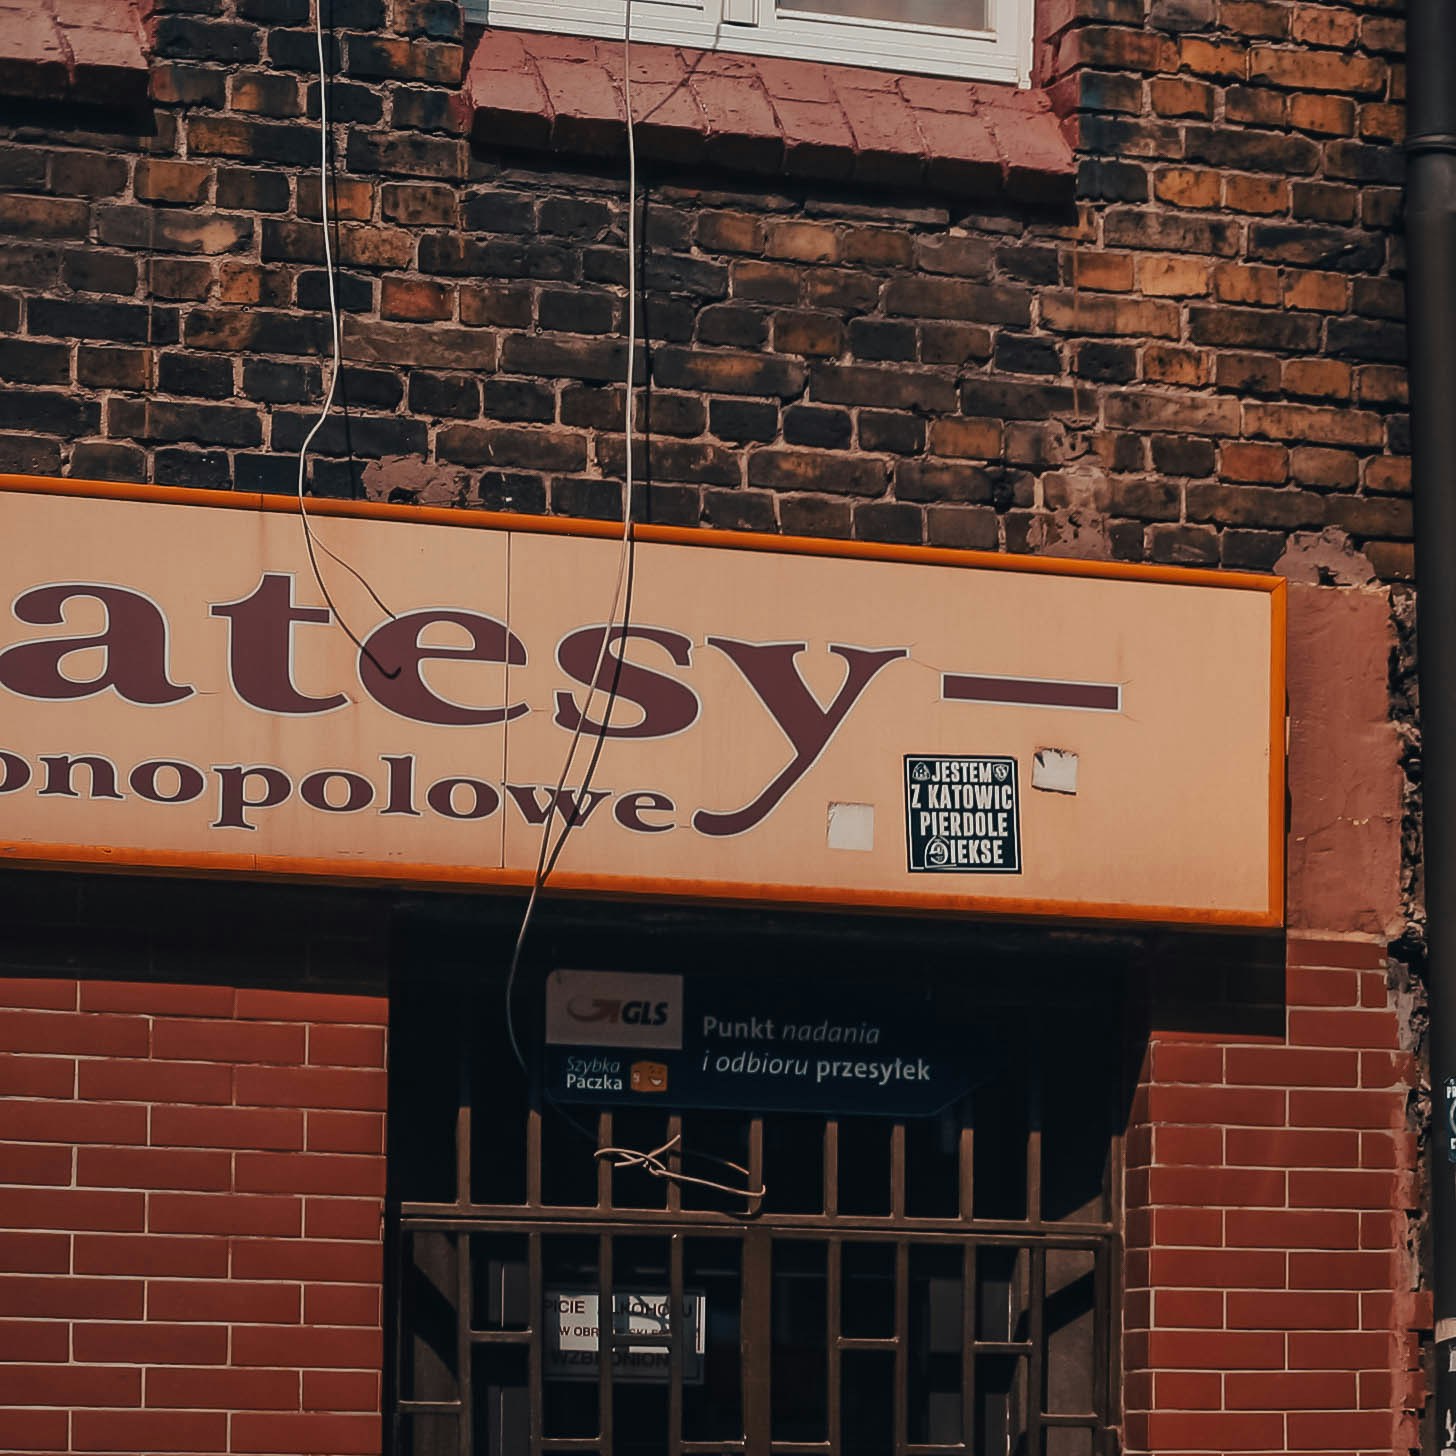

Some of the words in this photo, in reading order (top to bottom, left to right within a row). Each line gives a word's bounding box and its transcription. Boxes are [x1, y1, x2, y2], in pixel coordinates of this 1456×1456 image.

[0, 570, 909, 838] atesy
[931, 761, 992, 783] JESTEM
[911, 784, 921, 808] Z
[928, 784, 1012, 809] KATOWIC
[920, 811, 1008, 837] PIERDOLE
[622, 1001, 669, 1026] GLS
[703, 1015, 775, 1040] Punkt
[782, 1020, 879, 1045] nadania
[566, 1056, 621, 1076] Szybka
[703, 1050, 711, 1072] i
[715, 1050, 808, 1076] odbioru
[816, 1056, 931, 1086] przesyłek
[566, 1073, 623, 1091] Paczka
[543, 1300, 585, 1314] PICIE
